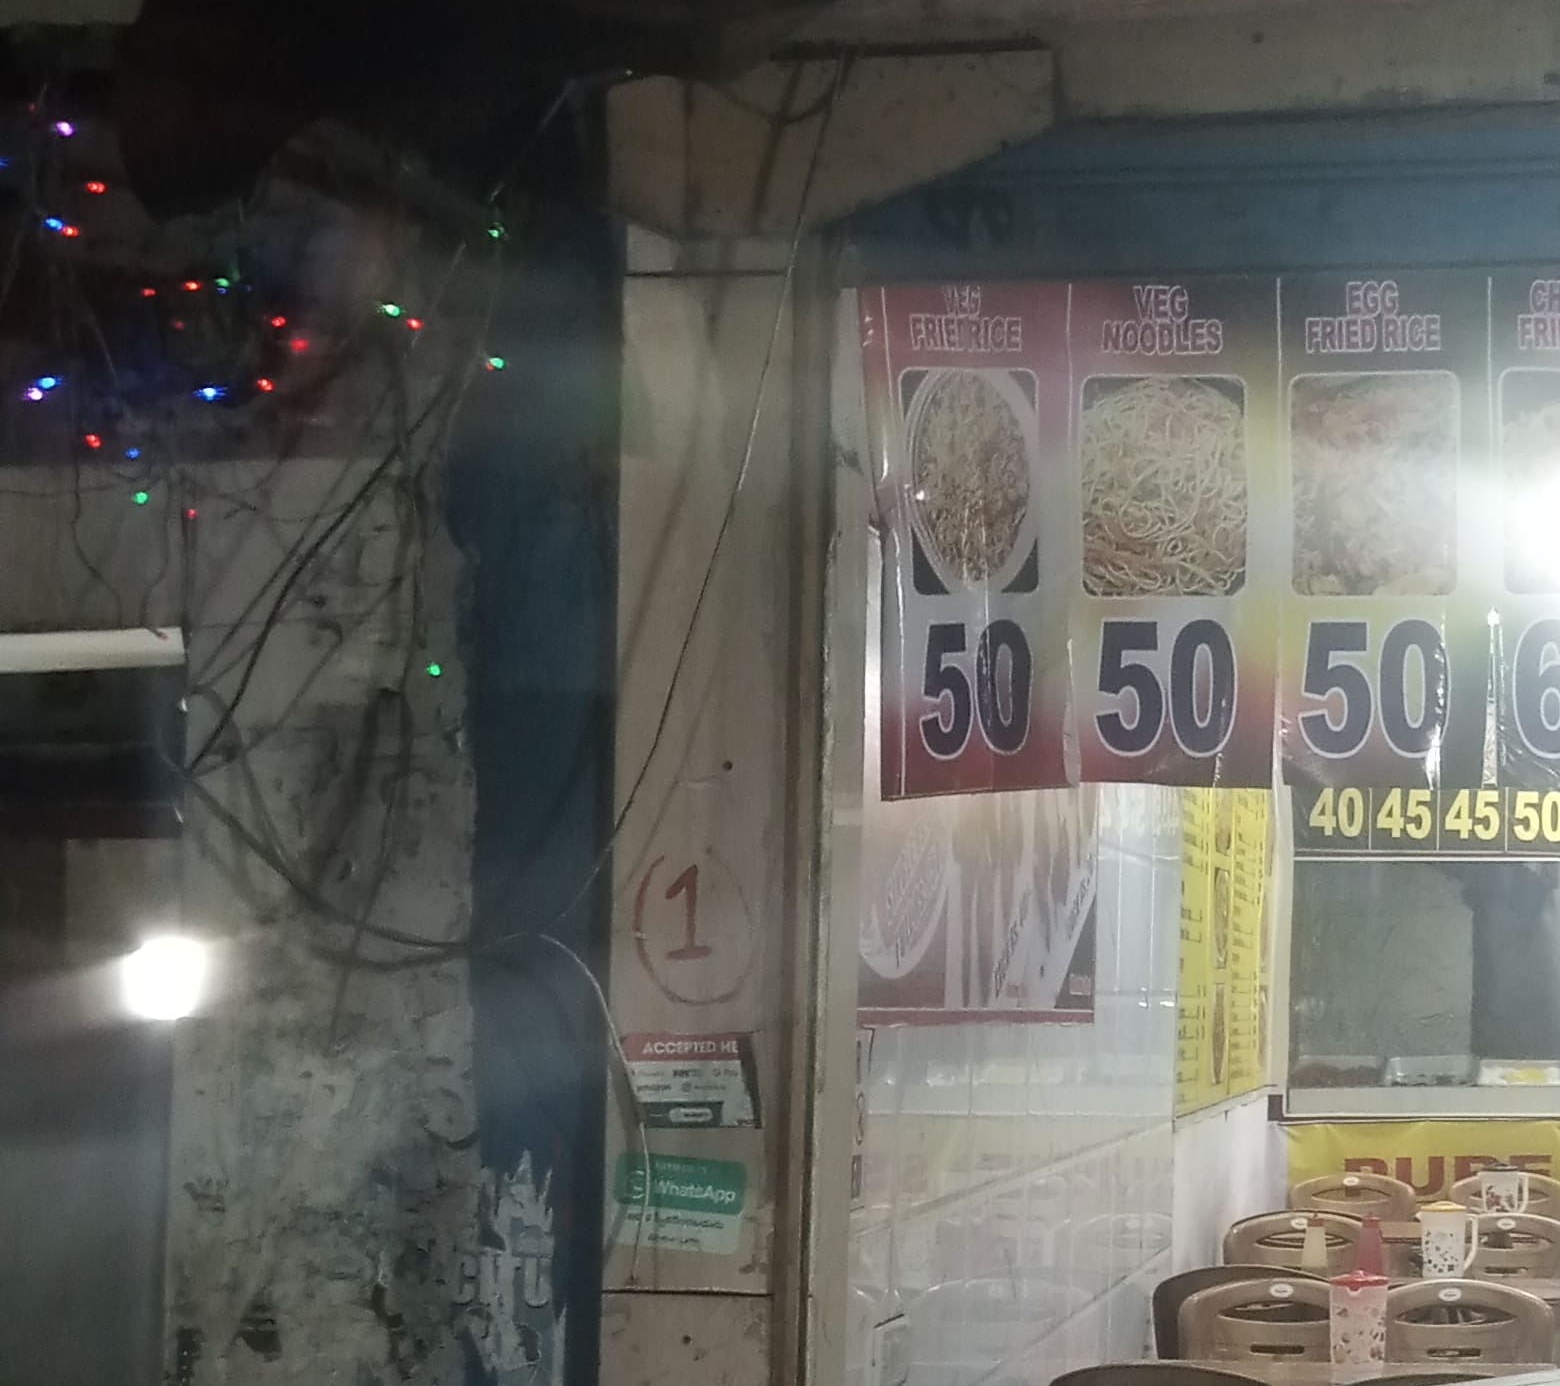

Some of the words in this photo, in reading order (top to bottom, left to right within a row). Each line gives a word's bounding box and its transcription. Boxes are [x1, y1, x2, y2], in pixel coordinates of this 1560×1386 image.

[1134, 286, 1188, 320] VEG
[1346, 281, 1398, 315] EGG
[1102, 319, 1223, 354] NOODLES
[1305, 317, 1377, 354] FRIED
[1382, 315, 1441, 352] RICE
[920, 618, 1032, 760] 50
[1095, 618, 1238, 758] 50
[1298, 618, 1451, 758] 50
[1309, 787, 1364, 837] 40
[1377, 788, 1431, 839] 45
[1445, 789, 1500, 840] 45
[643, 1040, 717, 1054] ACCEPTED
[655, 1179, 736, 1204] WhatsApp
